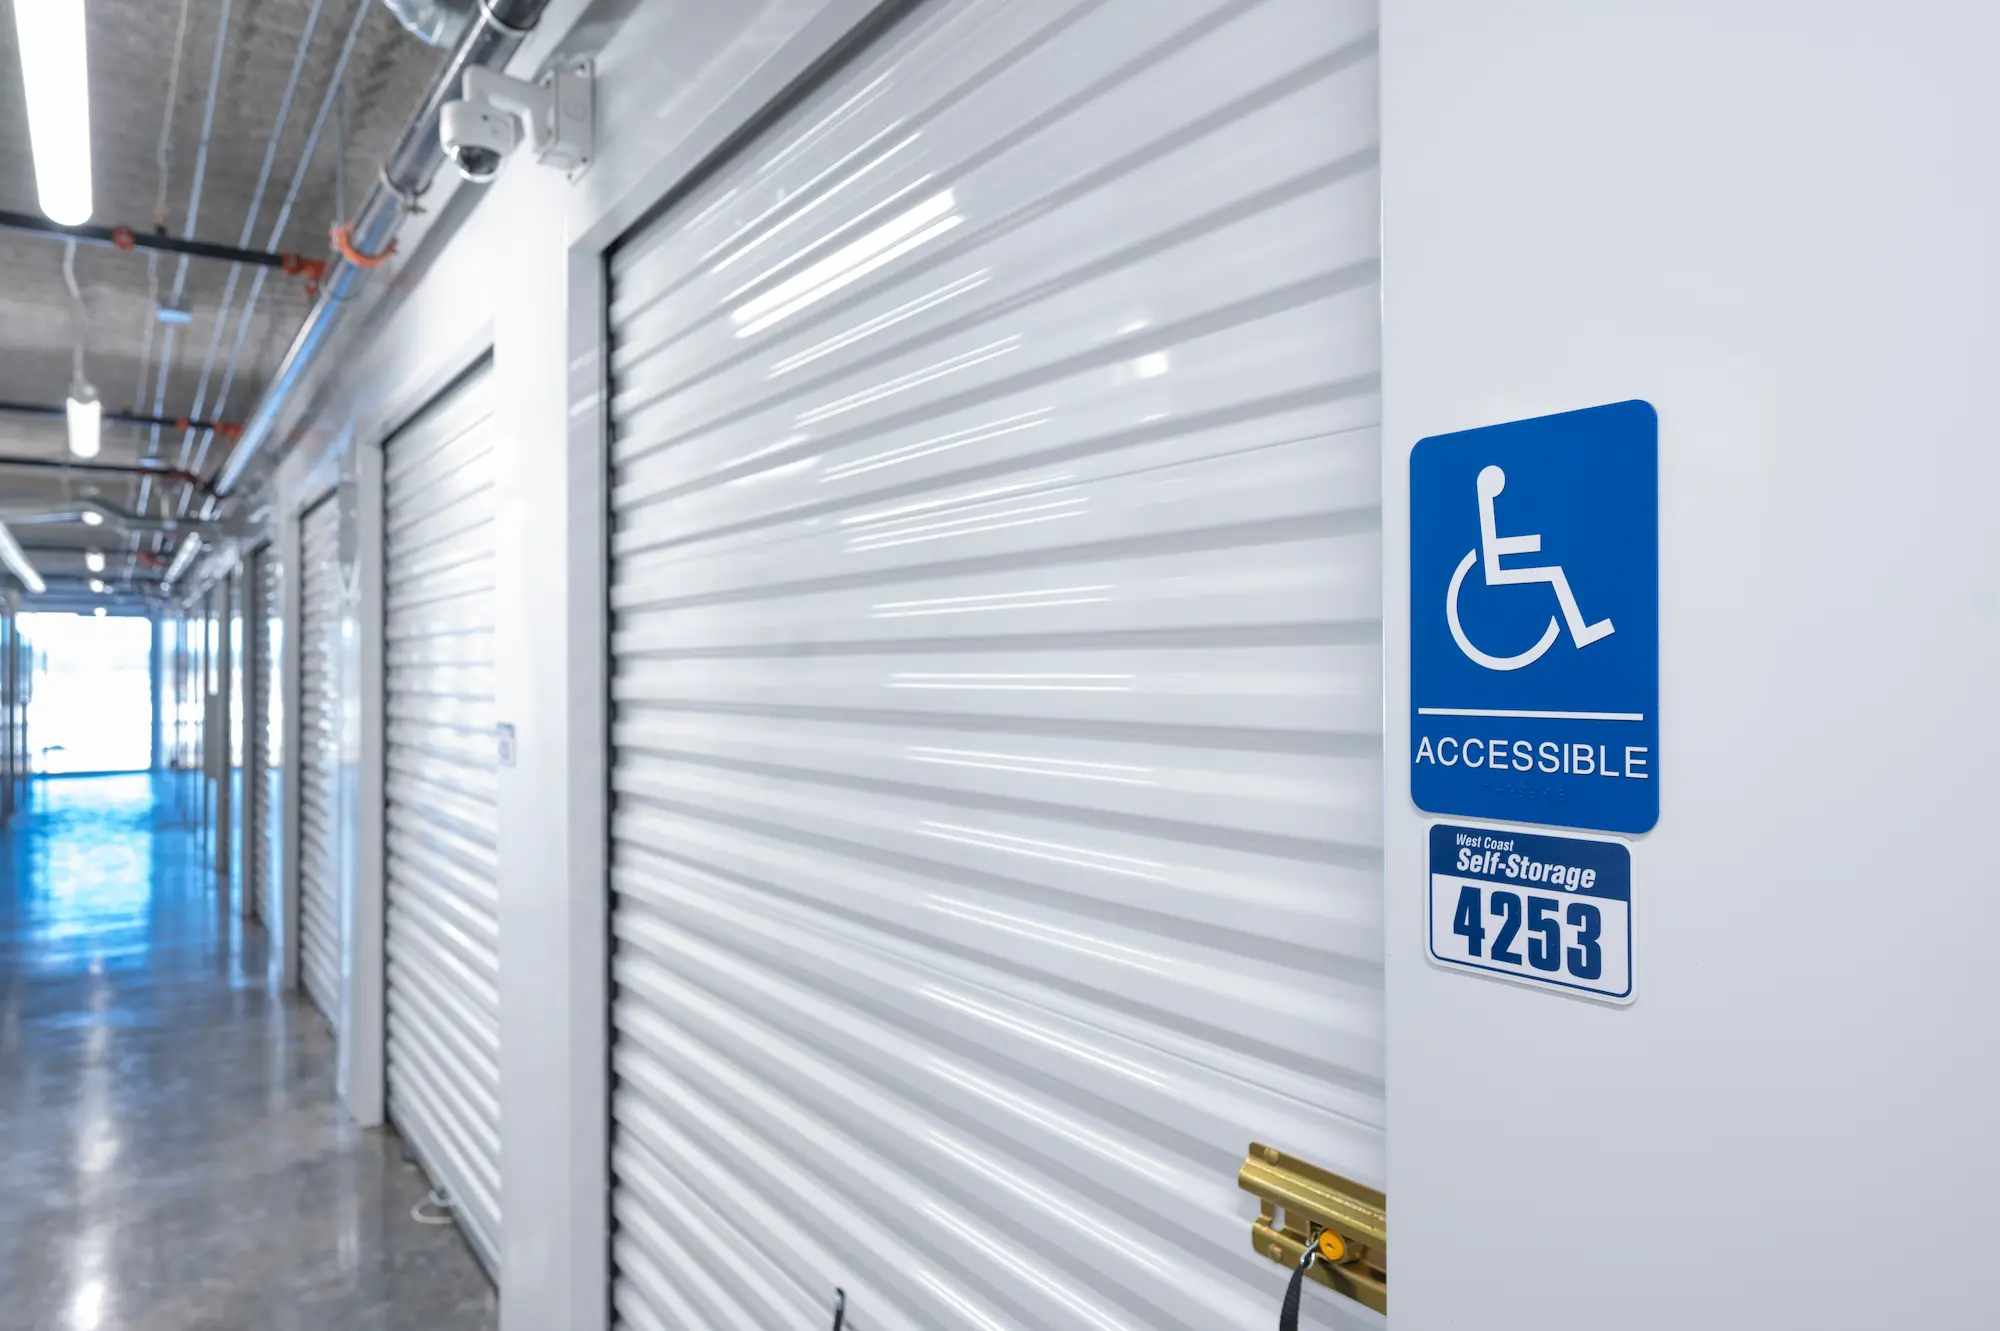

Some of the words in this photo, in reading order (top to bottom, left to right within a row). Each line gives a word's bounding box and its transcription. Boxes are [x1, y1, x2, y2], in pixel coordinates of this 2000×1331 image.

[1415, 736, 1648, 779] ACCESSIBLE
[1456, 833, 1481, 848] West
[1484, 837, 1514, 851] Coast
[1456, 848, 1596, 891] Self-Storage
[1453, 885, 1602, 980] 4253
